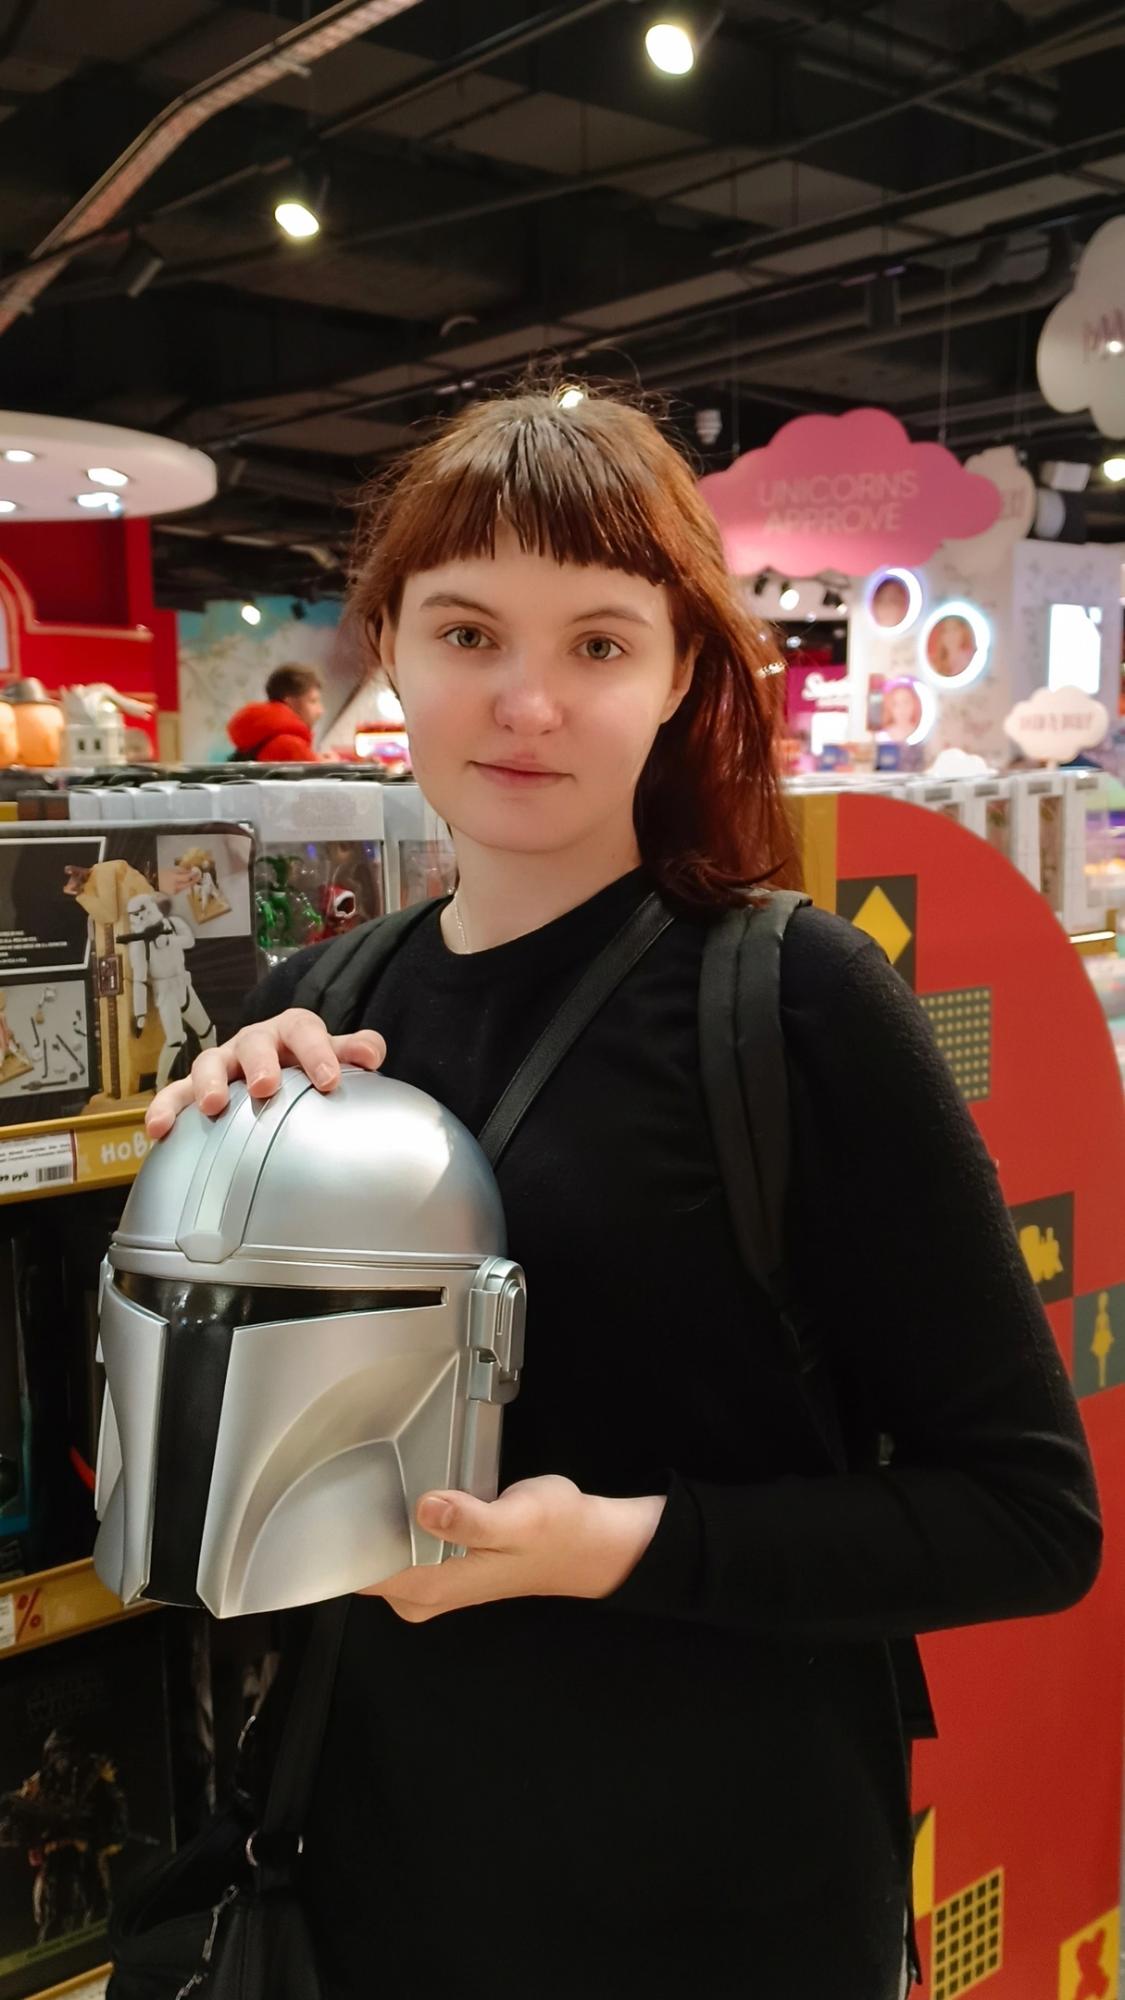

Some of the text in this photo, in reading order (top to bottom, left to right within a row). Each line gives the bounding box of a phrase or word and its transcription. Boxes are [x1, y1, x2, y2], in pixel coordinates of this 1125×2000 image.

[757, 471, 919, 507] UNICORNS
[763, 502, 902, 535] APPROVE
[101, 1131, 153, 1164] НОВ
